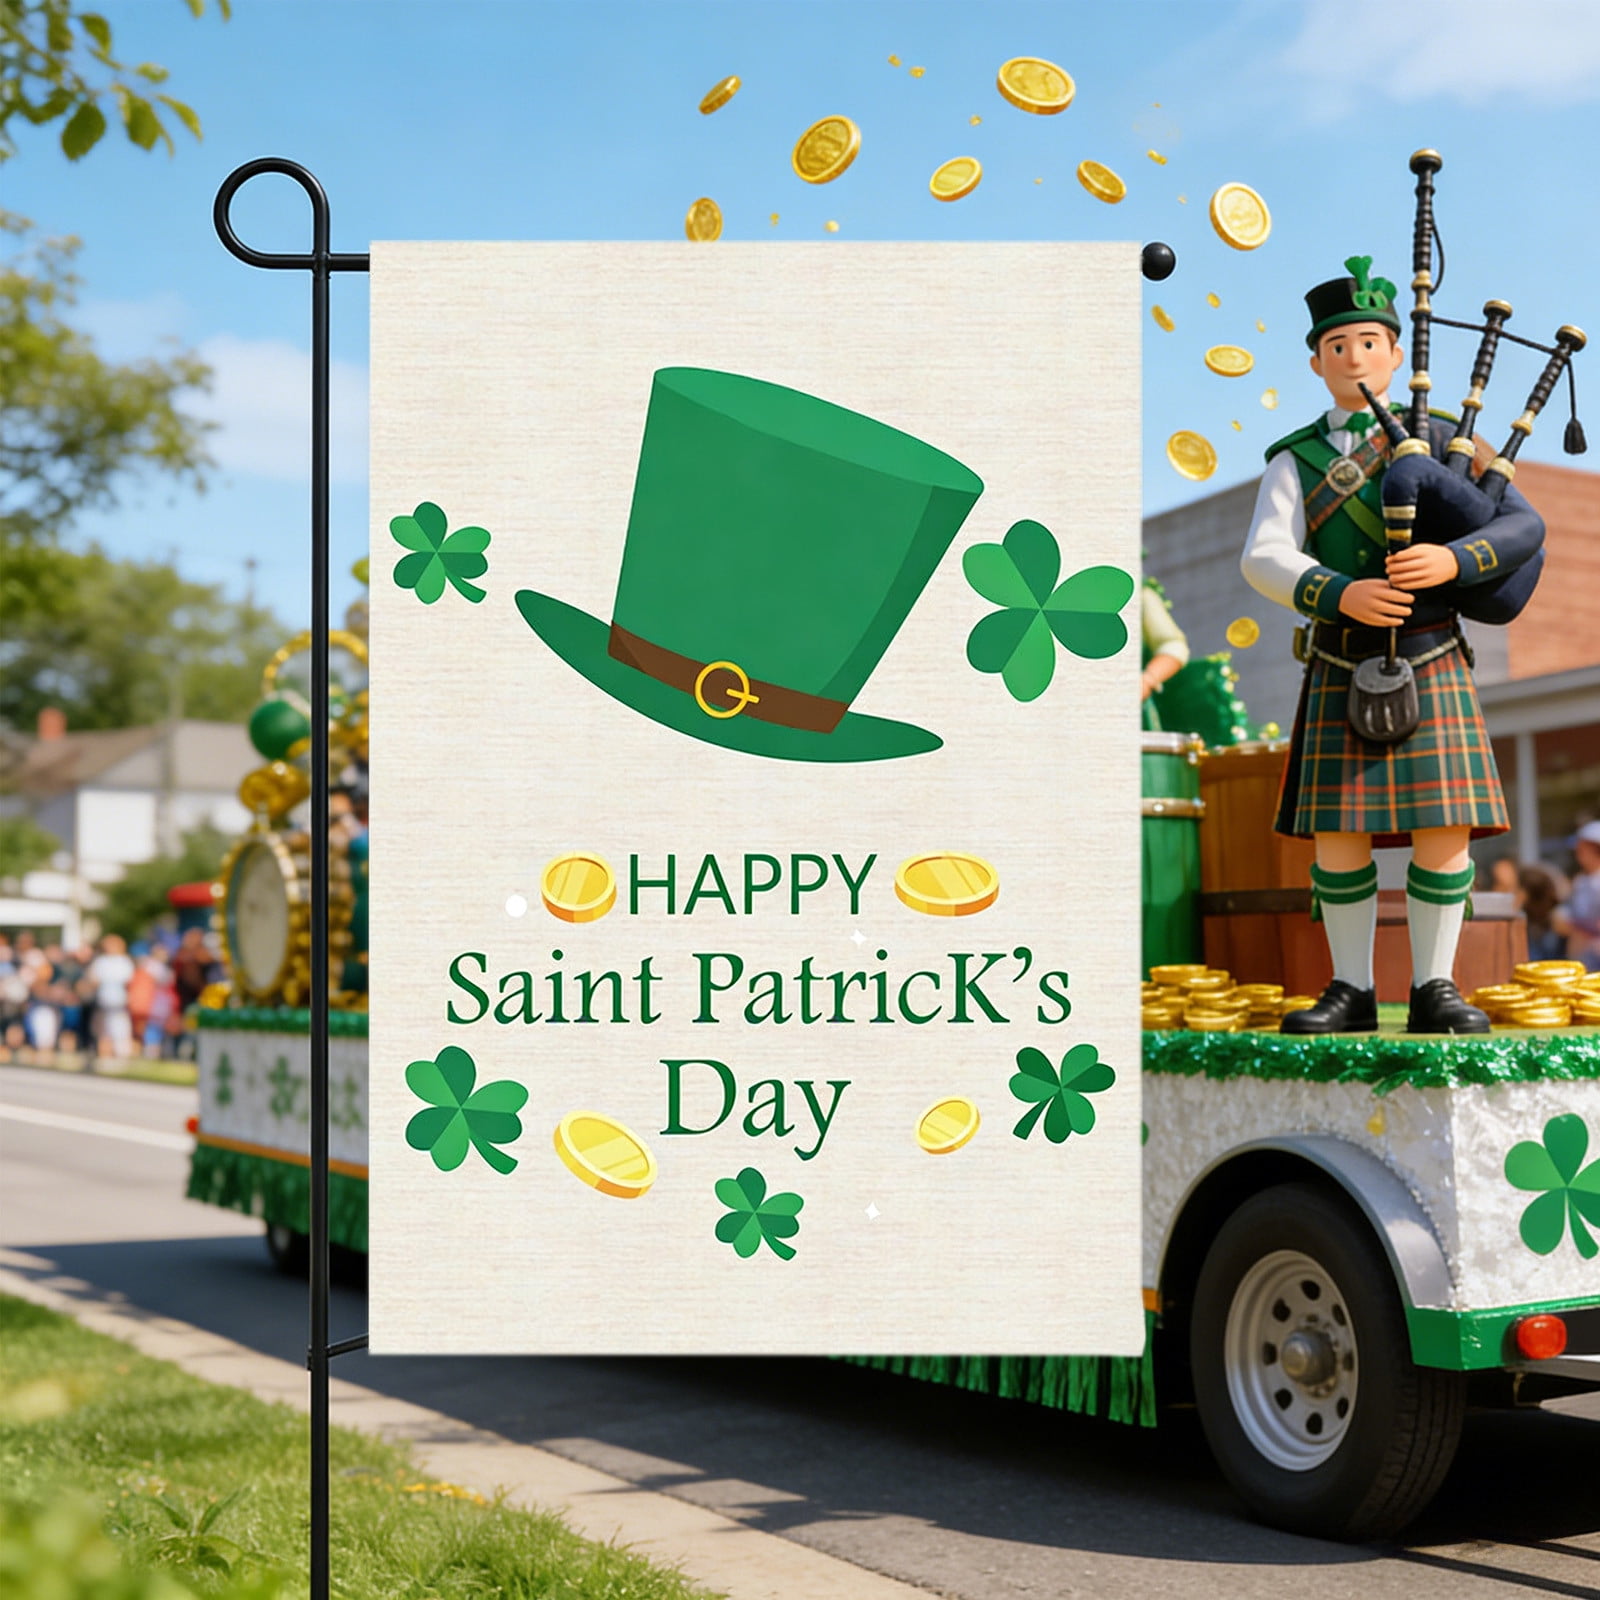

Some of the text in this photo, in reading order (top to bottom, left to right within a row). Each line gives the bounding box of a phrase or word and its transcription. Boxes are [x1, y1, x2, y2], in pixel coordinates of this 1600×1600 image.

[629, 853, 878, 915] HAPPY
[447, 949, 664, 1025] Saint
[659, 1059, 853, 1162] Day
